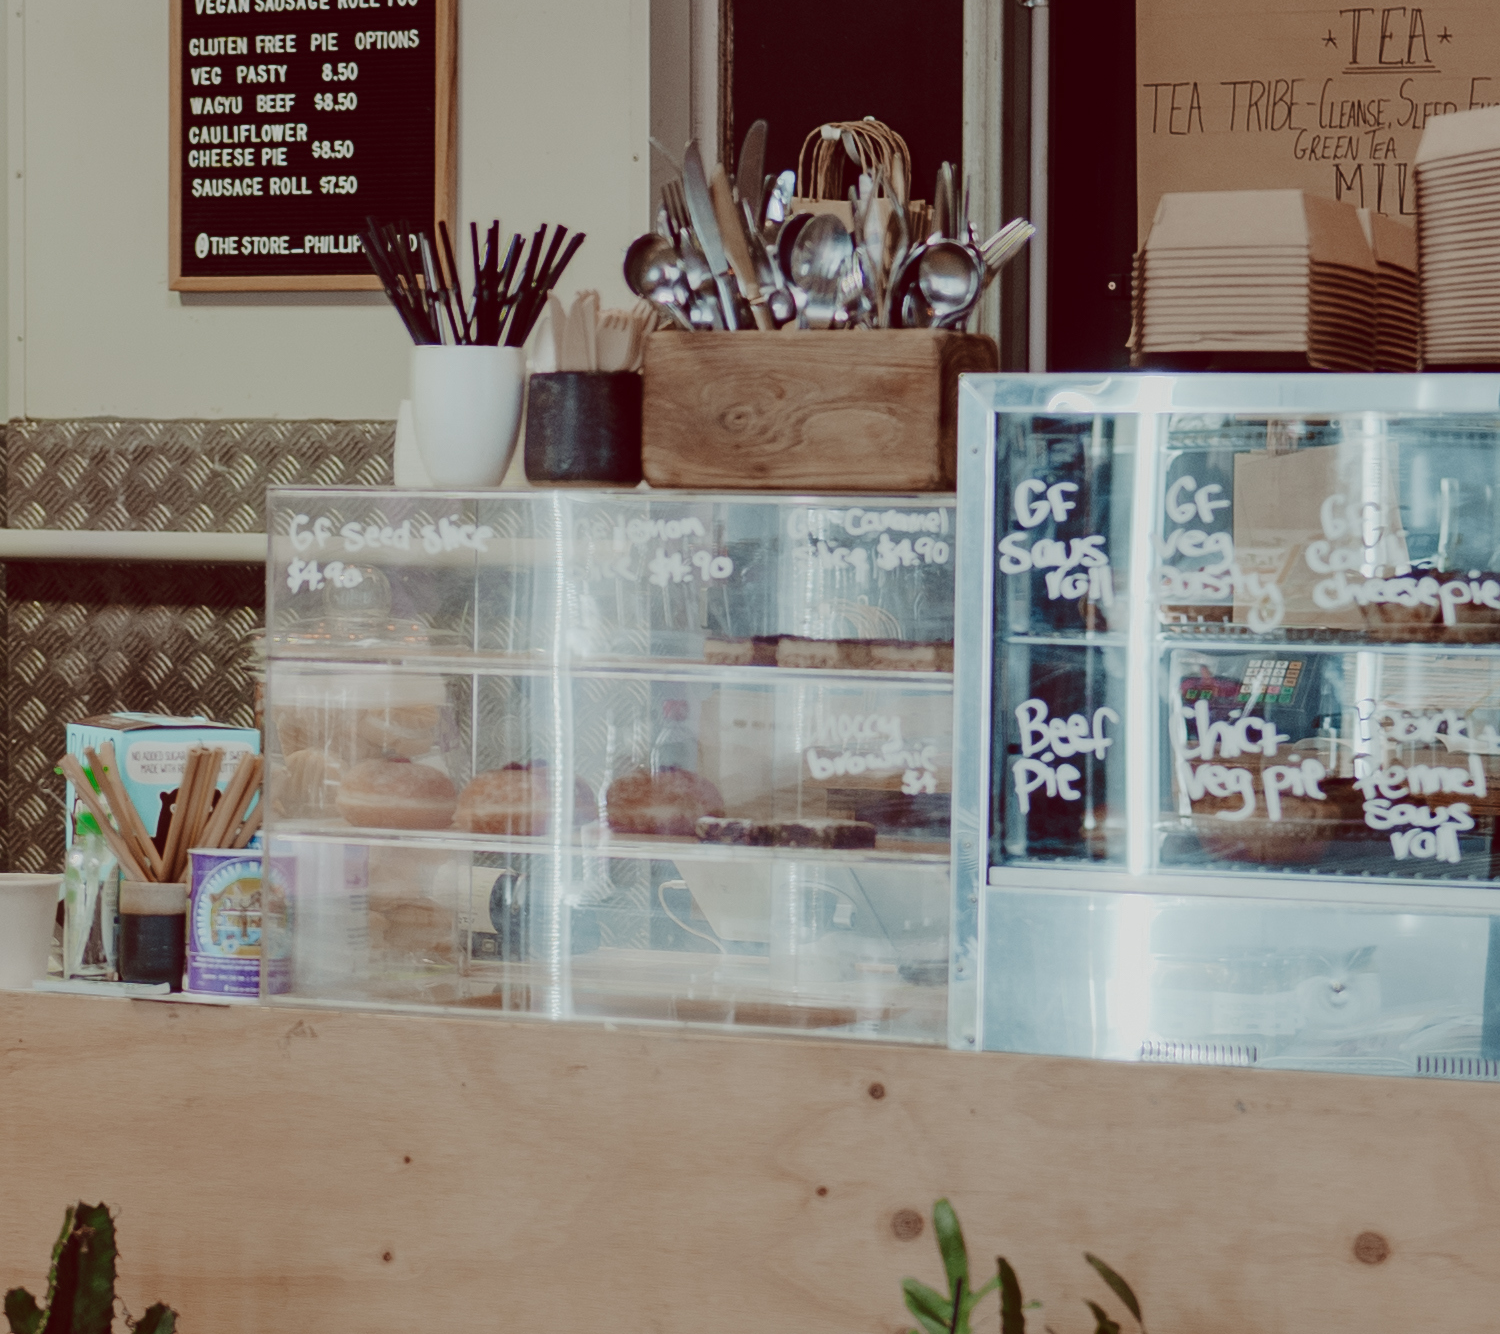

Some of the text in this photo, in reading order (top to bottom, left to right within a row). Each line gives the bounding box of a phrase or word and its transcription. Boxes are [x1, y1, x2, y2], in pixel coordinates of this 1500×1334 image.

[189, 29, 419, 56] GLUTEN FREE PIE OPTIONS
[1339, 7, 1432, 65] TEA
[191, 62, 358, 86] VEG PASTY 8.50
[190, 92, 358, 115] WAGYU BEEF $8.50
[1143, 82, 1204, 134] TEA
[188, 123, 308, 144] CAULIFLOWER
[1294, 128, 1359, 161] GREEN
[188, 140, 354, 168] CHEESE PIE $8.50
[192, 176, 358, 198] SAUSAGE ROLL $7.50
[1014, 478, 1079, 528] GF
[1165, 475, 1232, 524] GF
[1015, 698, 1120, 760] Beef
